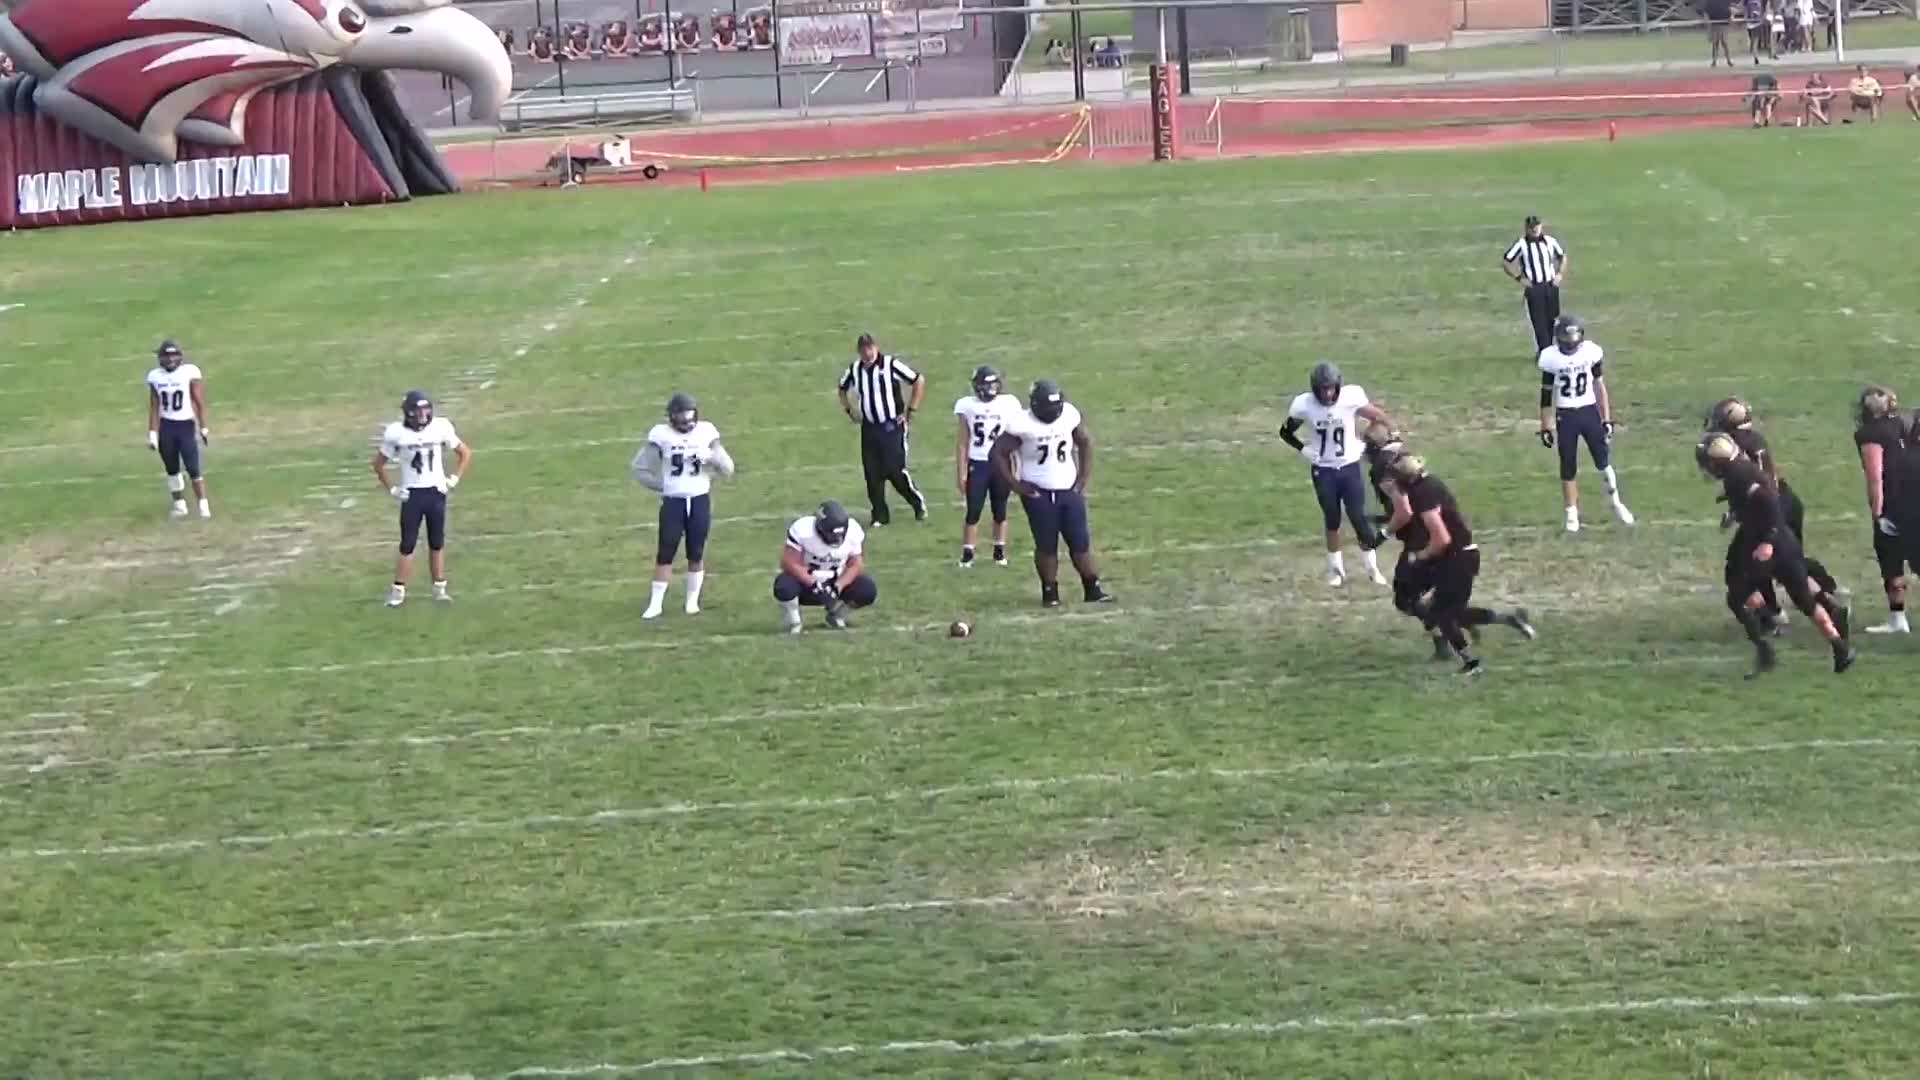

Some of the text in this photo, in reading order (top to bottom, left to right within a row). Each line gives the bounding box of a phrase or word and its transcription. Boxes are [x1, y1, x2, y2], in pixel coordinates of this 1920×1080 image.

[19, 154, 290, 214] MAPLE MOUNTAIN
[1560, 373, 1587, 397] 20
[1037, 440, 1066, 465] 76
[1316, 427, 1344, 457] 79
[411, 450, 434, 474] 41
